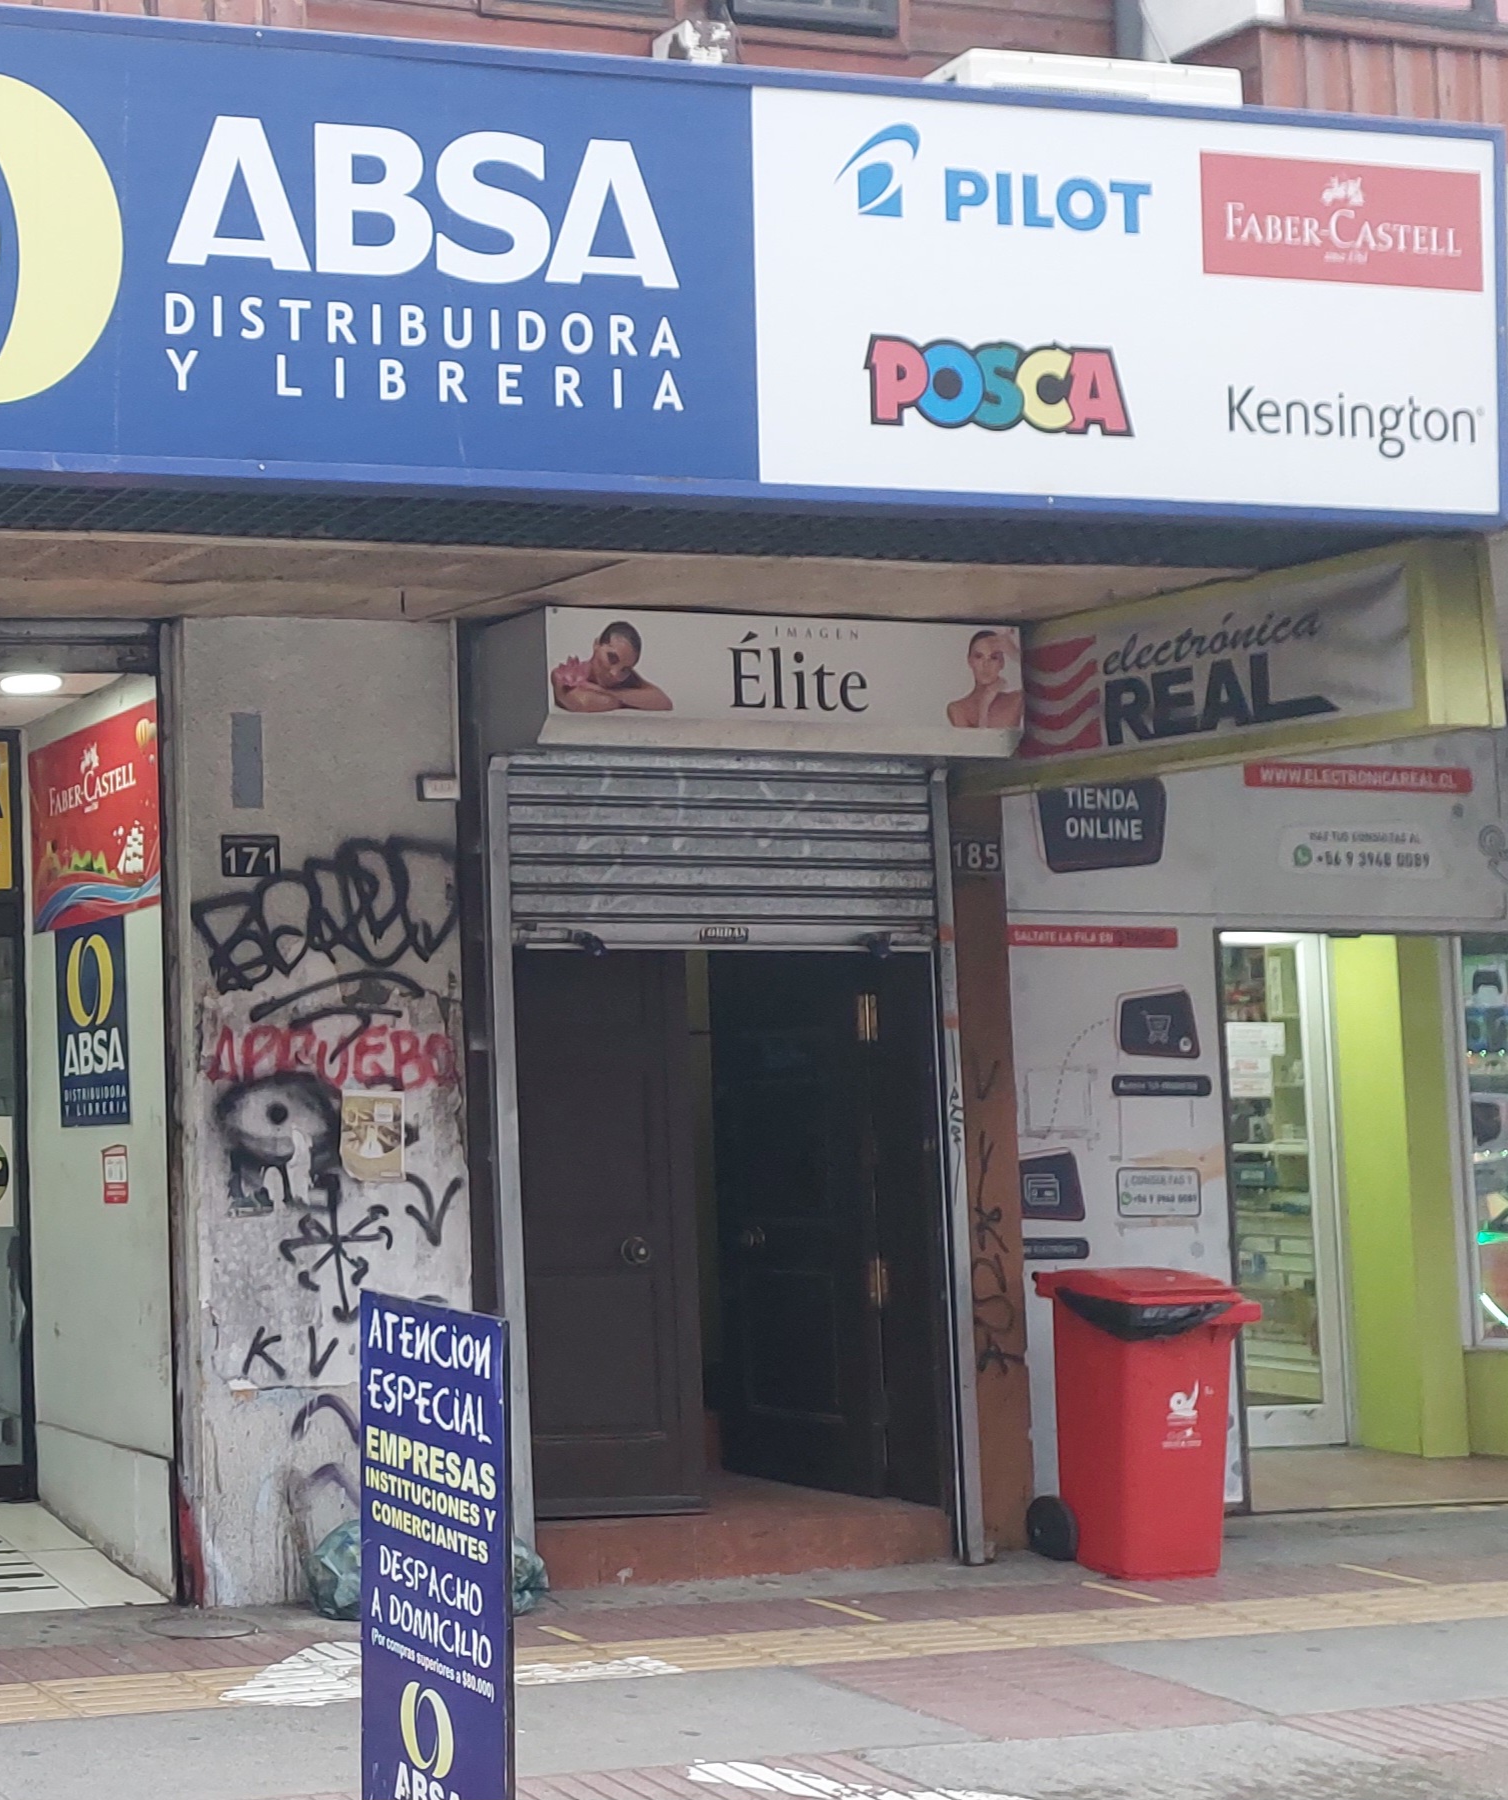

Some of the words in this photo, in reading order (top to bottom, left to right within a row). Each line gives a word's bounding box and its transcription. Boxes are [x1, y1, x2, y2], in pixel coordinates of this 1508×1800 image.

[166, 115, 680, 289] ABSA
[944, 166, 1153, 234] PILOT
[1224, 200, 1462, 258] FABER-CASTELL
[165, 292, 682, 359] DISTRIBUIDORA
[166, 349, 198, 391] Y
[276, 353, 684, 411] LIBRERIA
[865, 333, 1135, 437] POSCA
[1227, 385, 1478, 458] Kensington
[774, 625, 861, 641] IMAGEN
[1102, 608, 1321, 675] electrónica
[728, 631, 870, 712] Élite
[1103, 652, 1341, 746] REAL
[49, 762, 137, 817] FABER-CASTELL
[1066, 787, 1140, 811] TIENDA
[224, 846, 279, 874] 171
[953, 841, 1000, 869] 185
[1064, 816, 1144, 841] ONLINE
[63, 1027, 125, 1077] ABSA
[64, 1084, 127, 1103] DISTRIBUIDORA
[65, 1105, 71, 1117] Y
[76, 1100, 127, 1117] LIBRERIA
[365, 1424, 496, 1500] EMPRESAS
[365, 1466, 480, 1527] INSTITUCIONES
[482, 1508, 497, 1532] Y
[371, 1499, 489, 1564] COMERCIANTES
[379, 1544, 483, 1617] DESPACHO
[370, 1626, 386, 1646] (Por
[385, 1636, 416, 1662] compras
[416, 1649, 455, 1684] superiores
[455, 1672, 461, 1684] a
[371, 1586, 382, 1623] A
[389, 1594, 492, 1669] DOMICILIO
[394, 1761, 461, 1800] ABS
